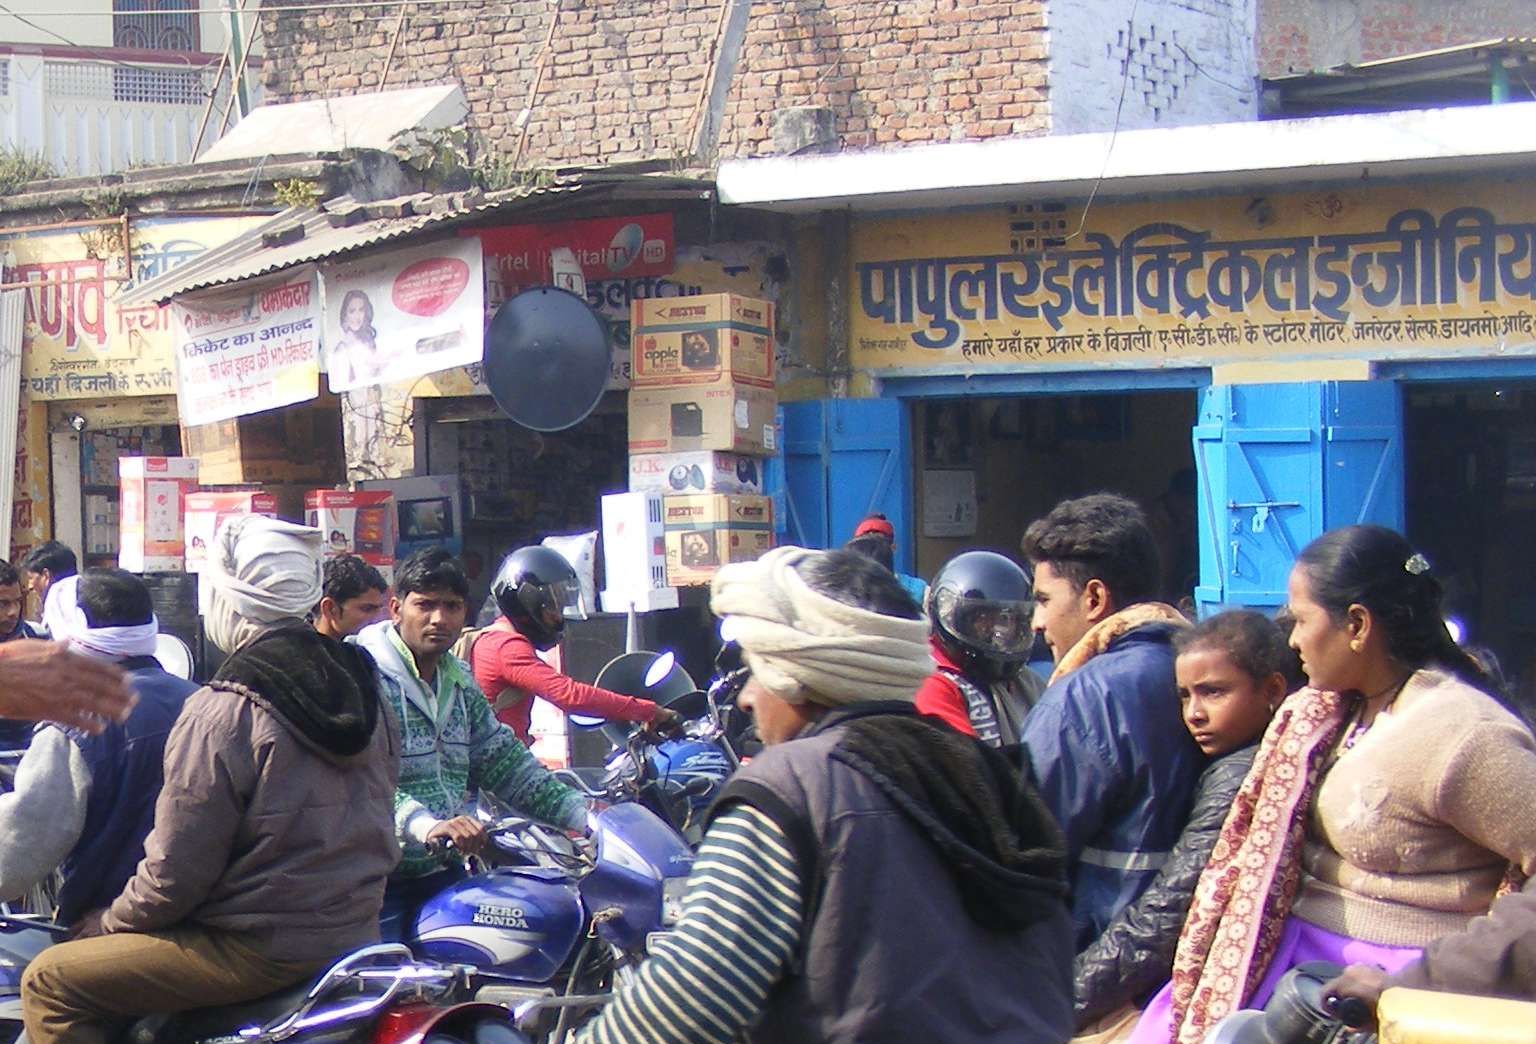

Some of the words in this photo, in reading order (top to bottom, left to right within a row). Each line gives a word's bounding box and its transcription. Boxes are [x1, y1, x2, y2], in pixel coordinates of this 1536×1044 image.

[961, 331, 995, 367] हमारे
[1046, 332, 1082, 357] प्रकार
[1087, 329, 1102, 351] के
[1104, 326, 1152, 353] बिजली
[1244, 319, 1258, 343] के
[644, 347, 678, 368] apple
[479, 904, 523, 918] HERO
[473, 913, 528, 928] HONDA
